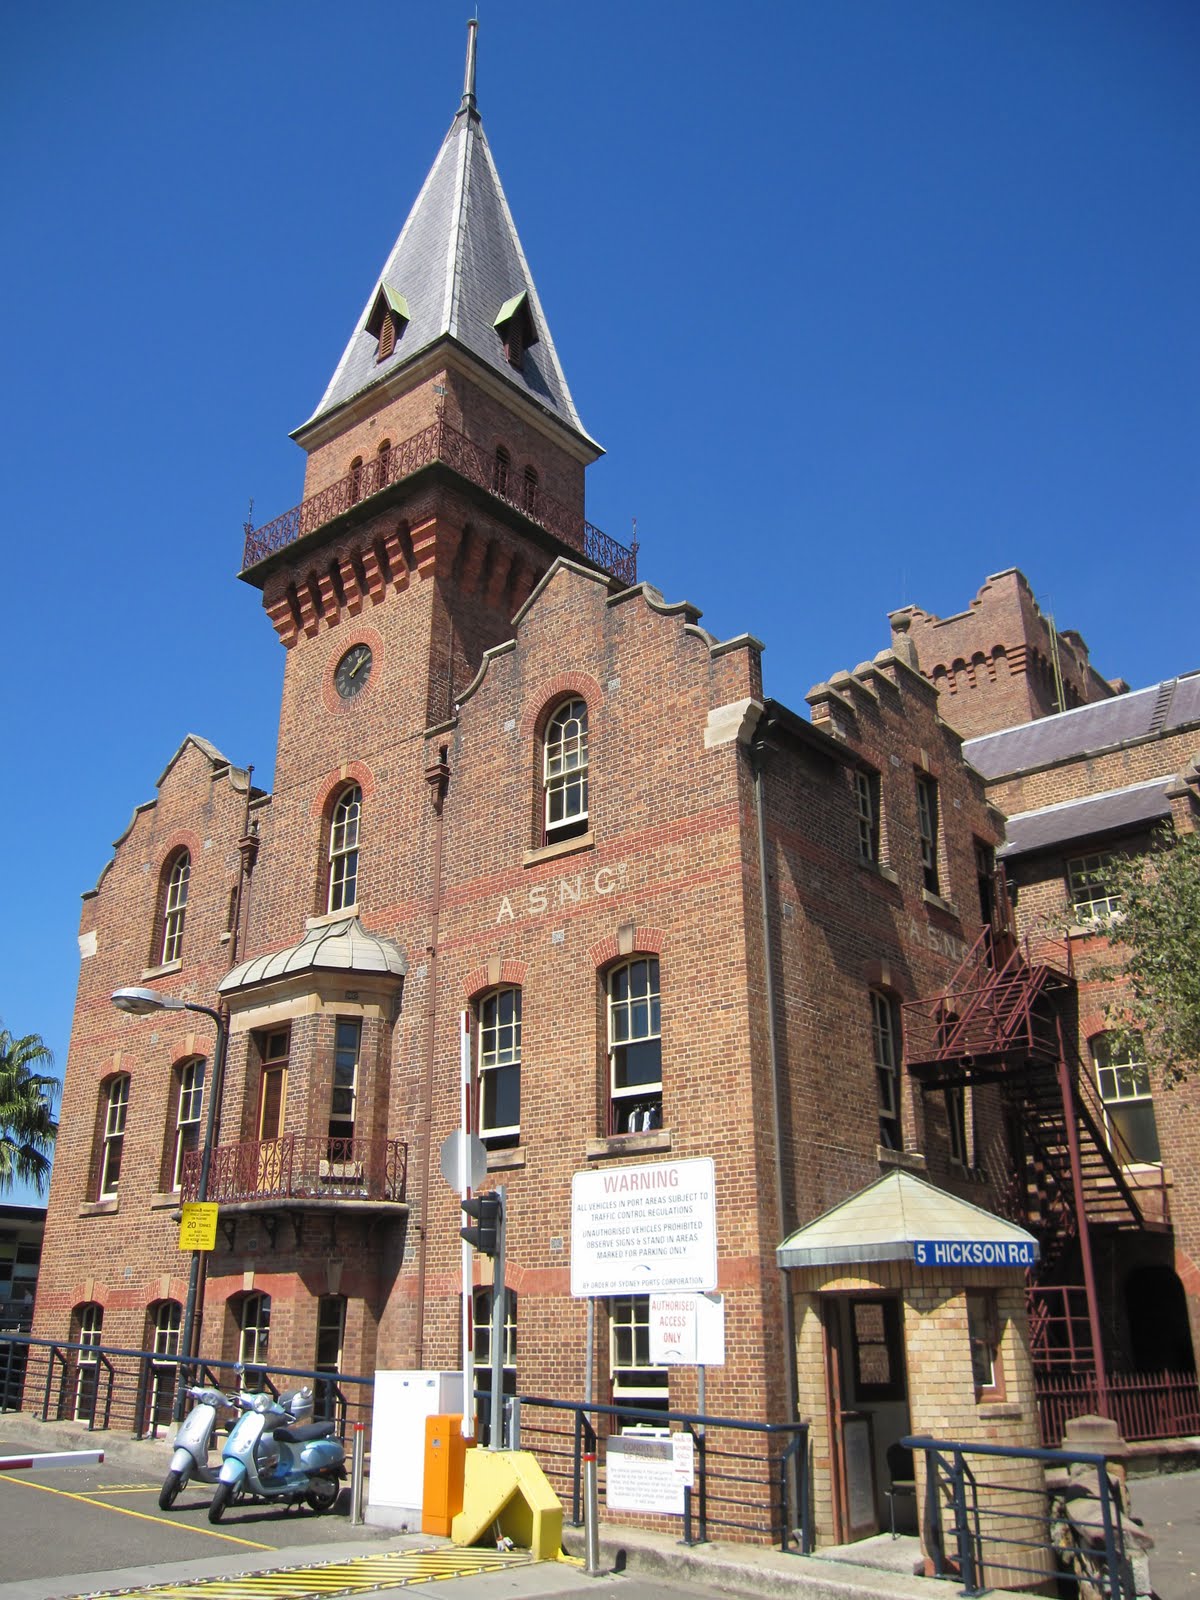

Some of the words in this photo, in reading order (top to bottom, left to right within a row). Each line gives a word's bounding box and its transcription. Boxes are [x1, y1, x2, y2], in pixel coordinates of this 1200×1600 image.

[603, 1169, 679, 1193] WARNING
[577, 1204, 587, 1212] ALL
[589, 1201, 617, 1211] VEHICLES
[627, 1198, 643, 1207] PORT
[645, 1196, 667, 1205] AREAS
[669, 1193, 697, 1203] SUBJECT
[700, 1192, 709, 1200] TO
[591, 1211, 615, 1221] TRAFFIC
[617, 1209, 646, 1219] CONTROL
[648, 1205, 693, 1217] REGULATIONS
[582, 1226, 630, 1238] UNAUTHORISED
[632, 1224, 662, 1234] VEHICLES
[663, 1221, 703, 1231] PROHIBITED
[586, 1240, 613, 1249] OBSERVE
[616, 1238, 635, 1247] SIGNS
[643, 1236, 665, 1245] STAND
[667, 1235, 674, 1243] IN
[676, 1233, 698, 1242] AREAS
[597, 1250, 623, 1259] MARKED
[625, 1249, 637, 1257] FOR
[639, 1247, 668, 1256] PARKING
[669, 1246, 687, 1254] ONLY
[917, 1243, 926, 1263] 5
[934, 1243, 1006, 1264] HICKSON
[1008, 1243, 1033, 1264] Rd.
[583, 1281, 590, 1289] BY
[591, 1280, 609, 1288] ORDER
[610, 1280, 617, 1288] OF
[618, 1278, 641, 1287] SYDNEY
[642, 1278, 660, 1286] PORTS
[661, 1276, 703, 1286] CORPORATION
[652, 1300, 695, 1311] AUTHORISED
[660, 1316, 686, 1327] ACCESS
[663, 1332, 681, 1343] ONLY
